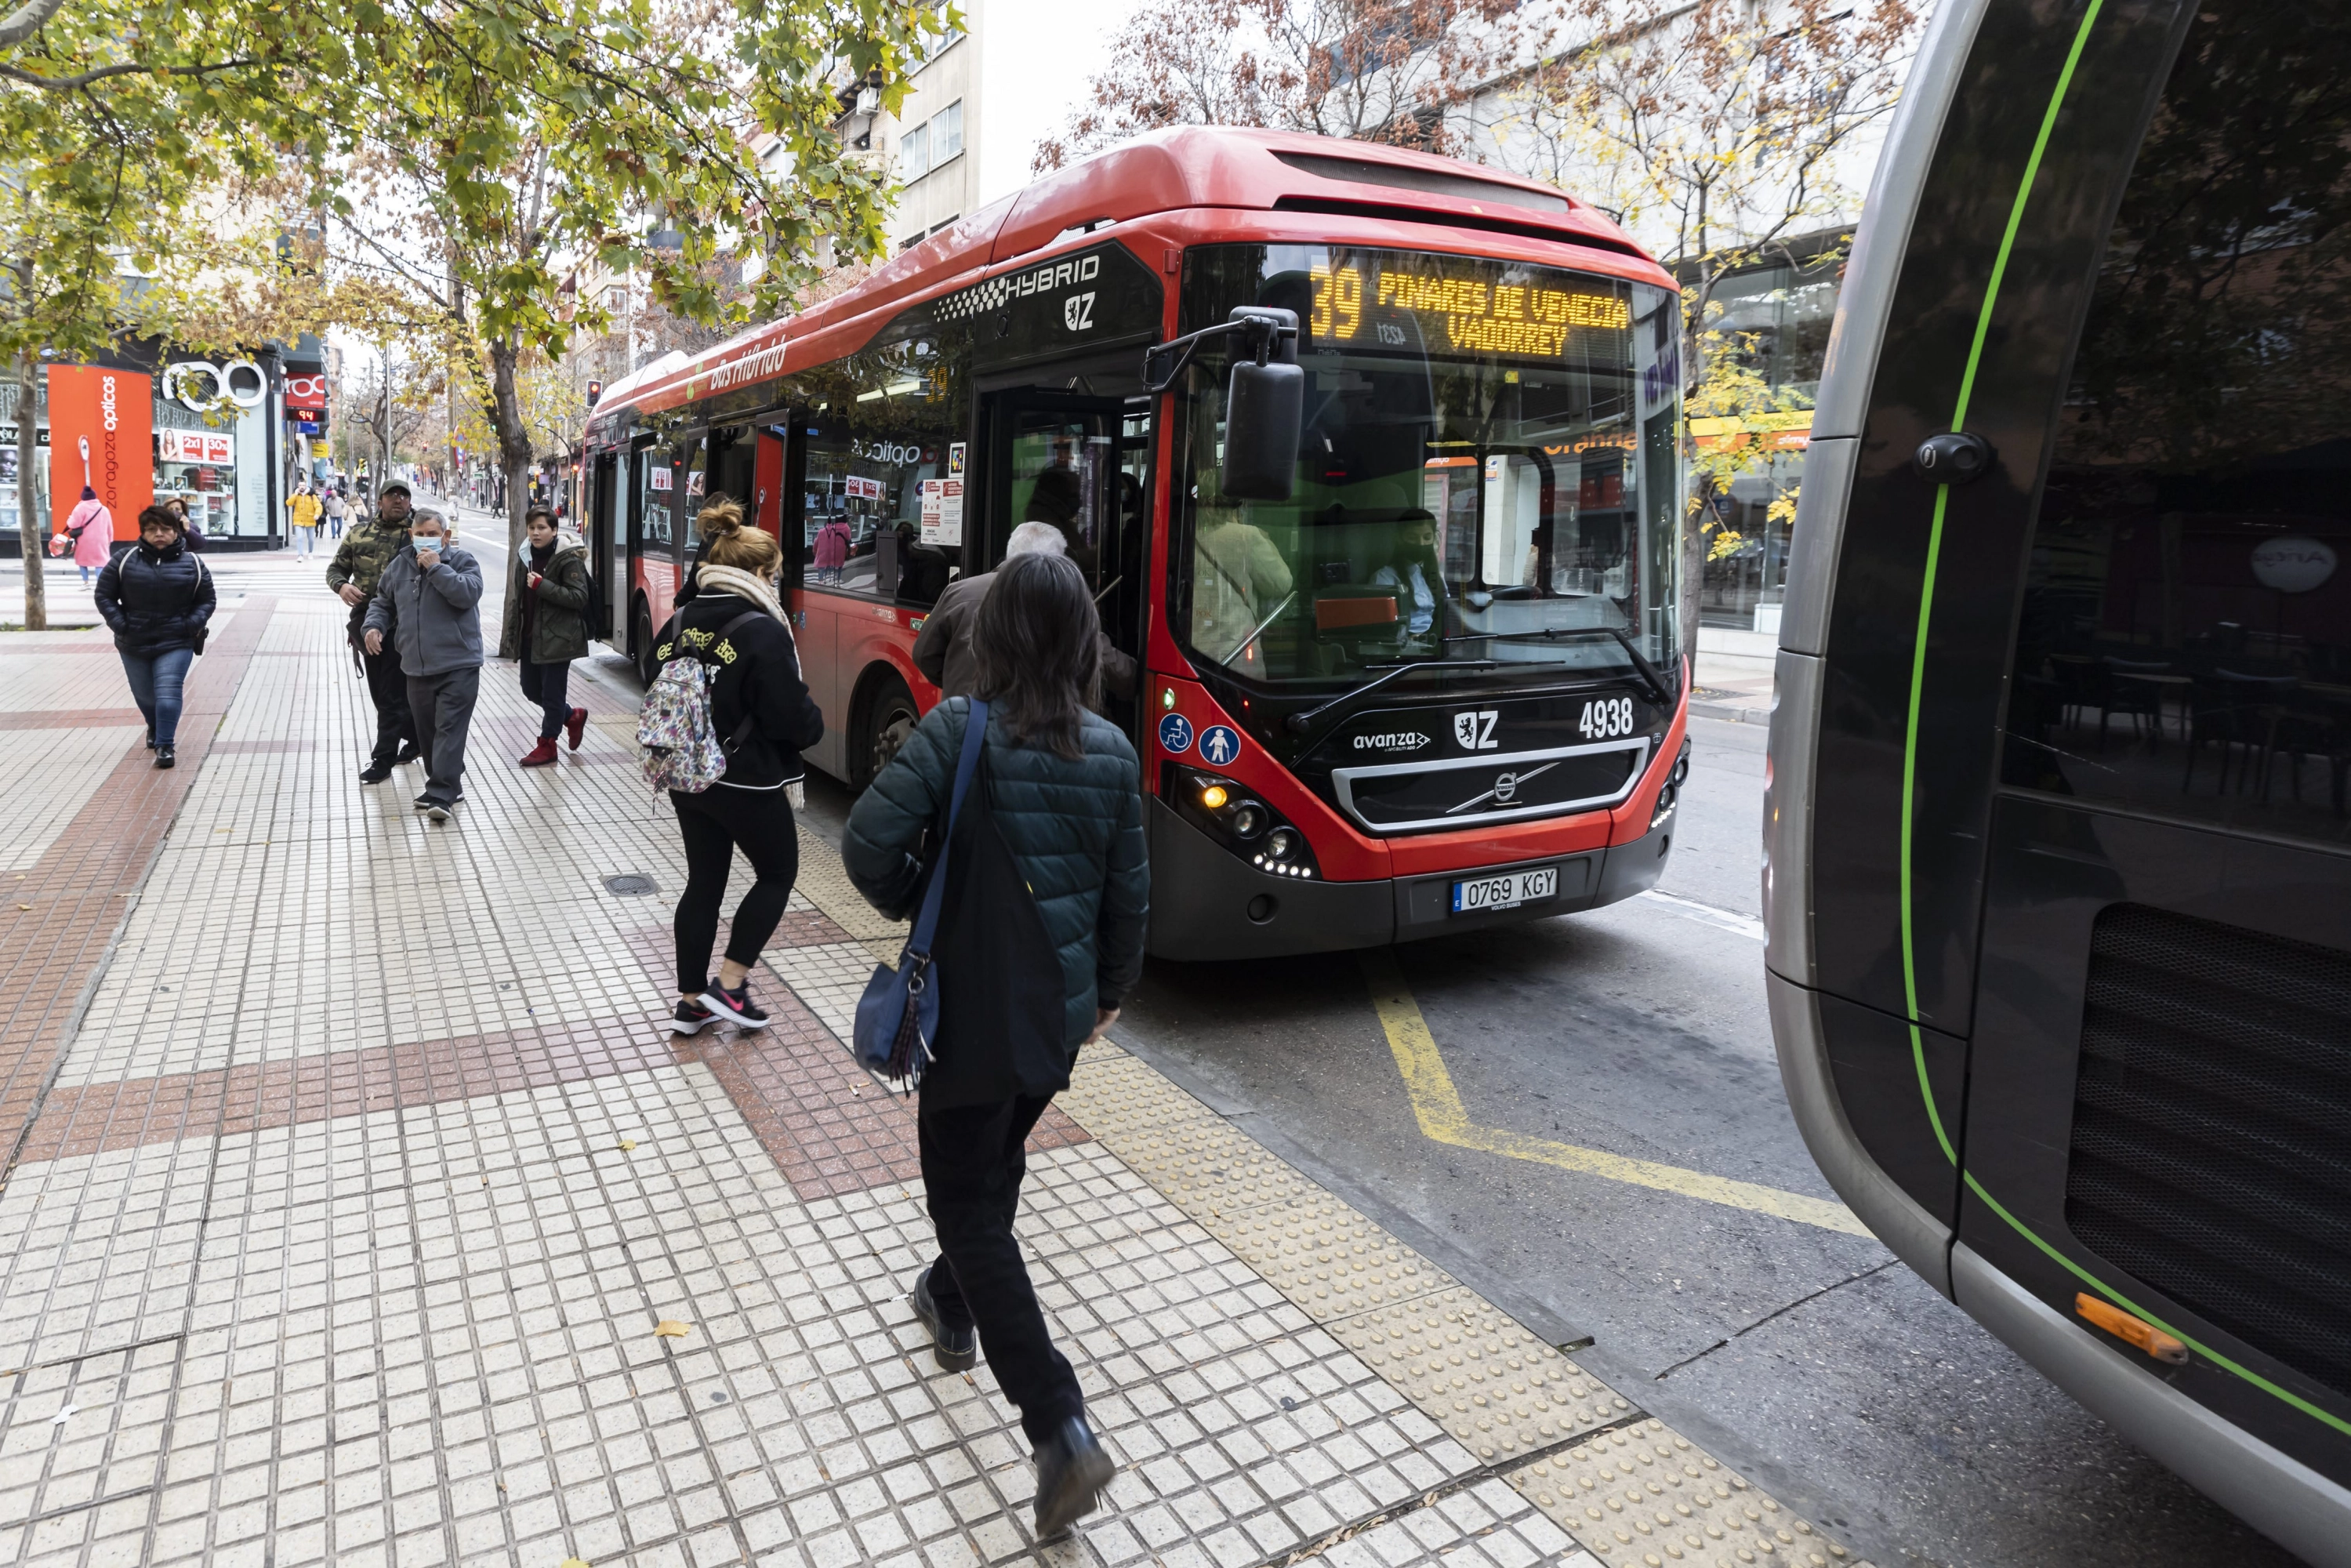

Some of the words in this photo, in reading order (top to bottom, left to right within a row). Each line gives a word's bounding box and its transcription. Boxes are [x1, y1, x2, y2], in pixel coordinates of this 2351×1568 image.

[1005, 255, 1100, 300] HYBRID
[1310, 264, 1362, 339] 39
[1378, 272, 1487, 315] PINARES
[1493, 285, 1524, 319] DE
[1531, 289, 1627, 329] VENECIA
[1448, 315, 1567, 356] VADORREY
[710, 358, 732, 390] Bus
[183, 437, 201, 448] 2x1
[1579, 697, 1634, 739] 4938
[1353, 731, 1416, 749] avanza
[1468, 878, 1512, 906] 0769
[1522, 870, 1555, 898] KGY
